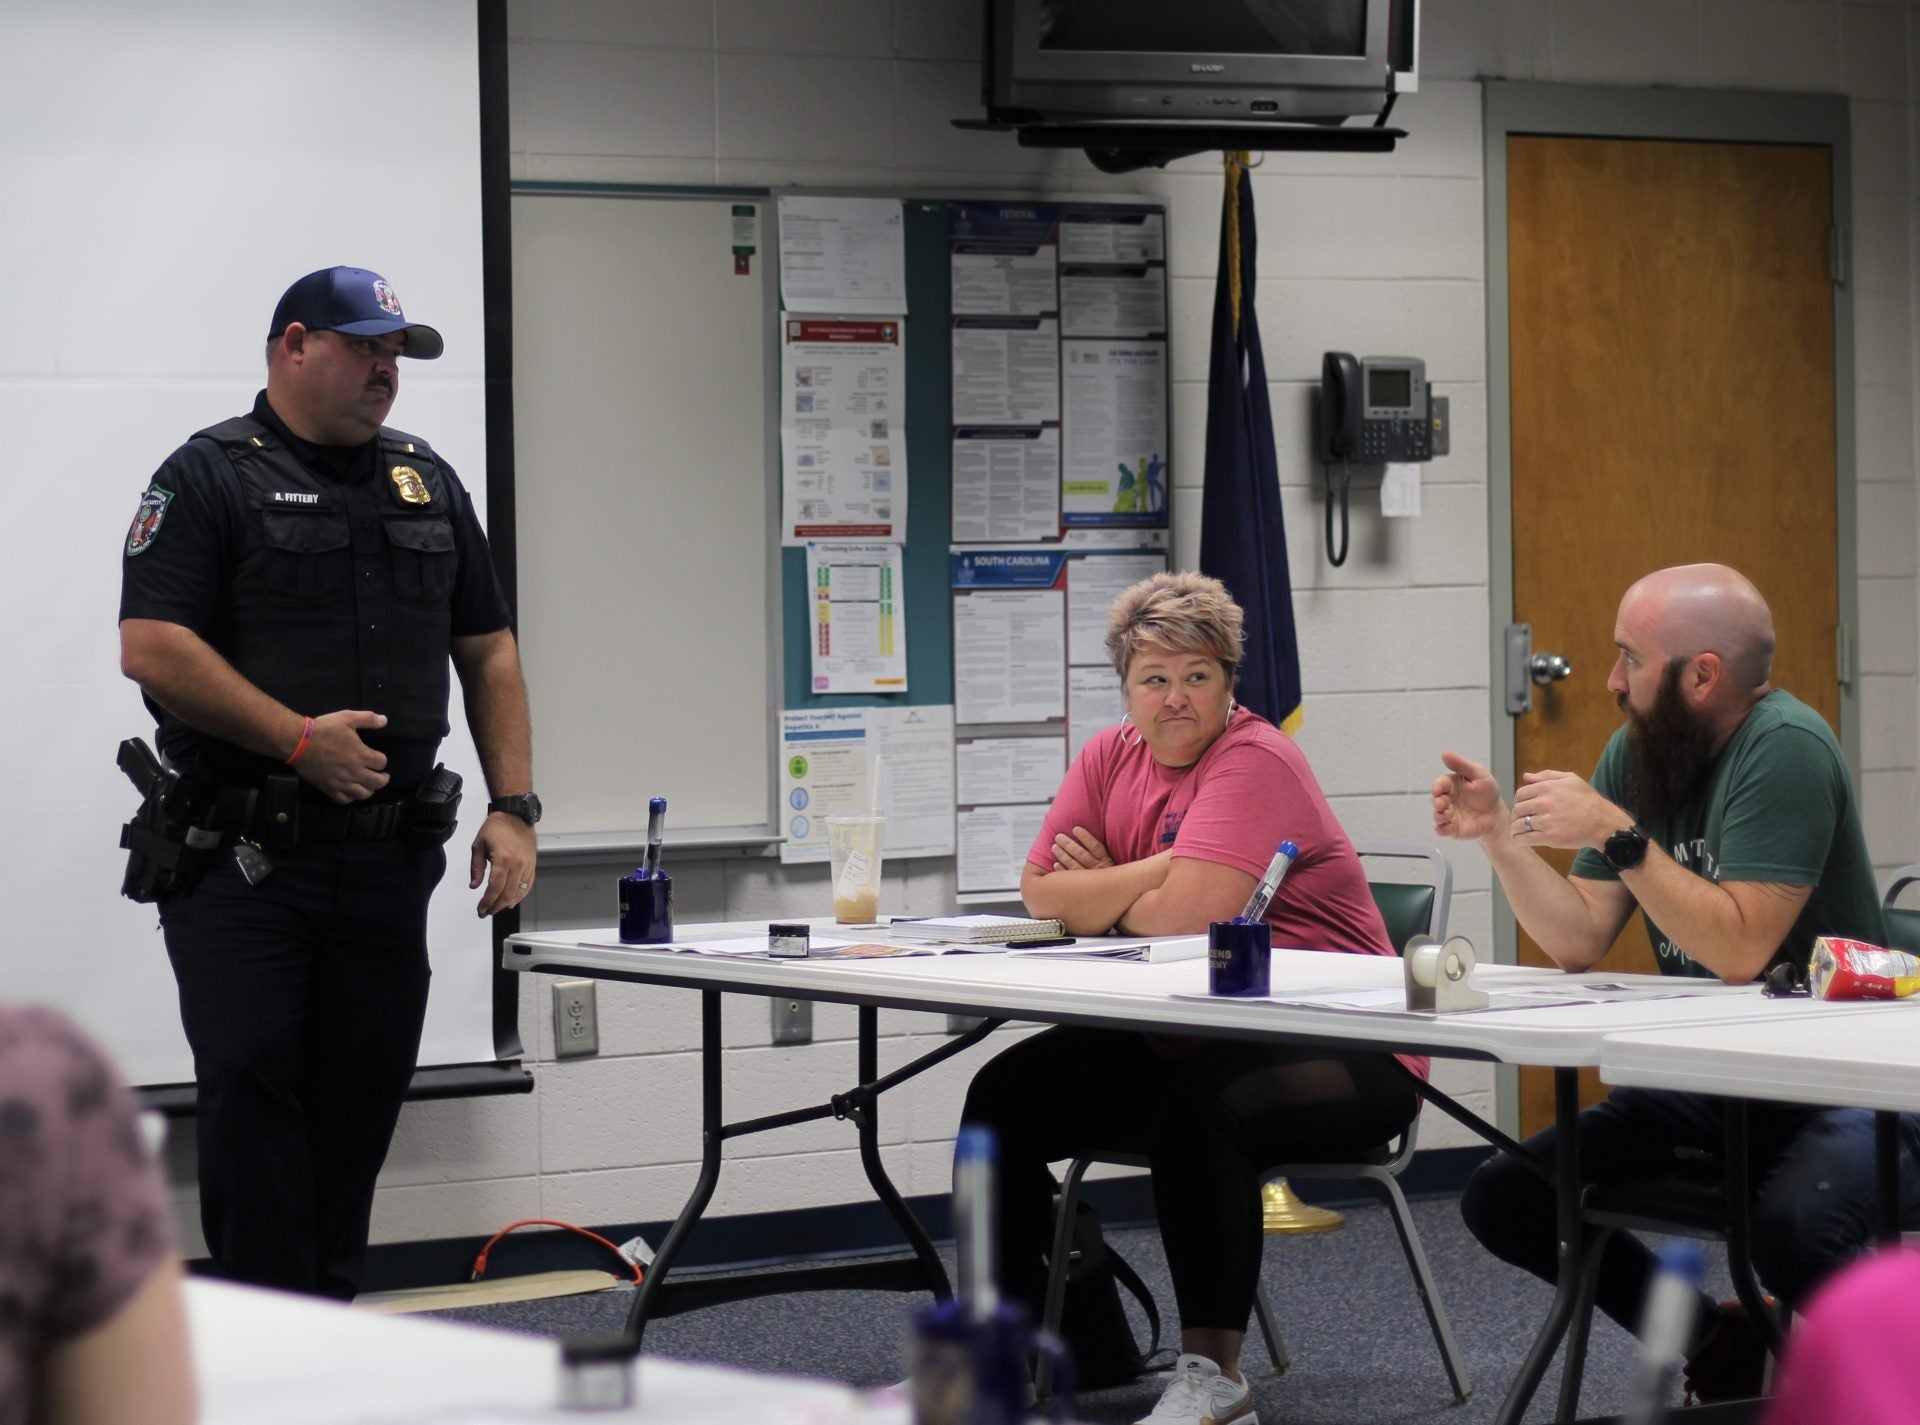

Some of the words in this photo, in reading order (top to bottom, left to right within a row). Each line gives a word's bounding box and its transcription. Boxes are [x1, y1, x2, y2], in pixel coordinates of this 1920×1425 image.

[999, 209, 1037, 220] FEDERAL
[275, 492, 284, 501] A.
[285, 492, 319, 504] FITTERY
[974, 556, 1005, 567] SOUTH
[1006, 556, 1050, 567] CAROLINA
[837, 712, 862, 721] Against
